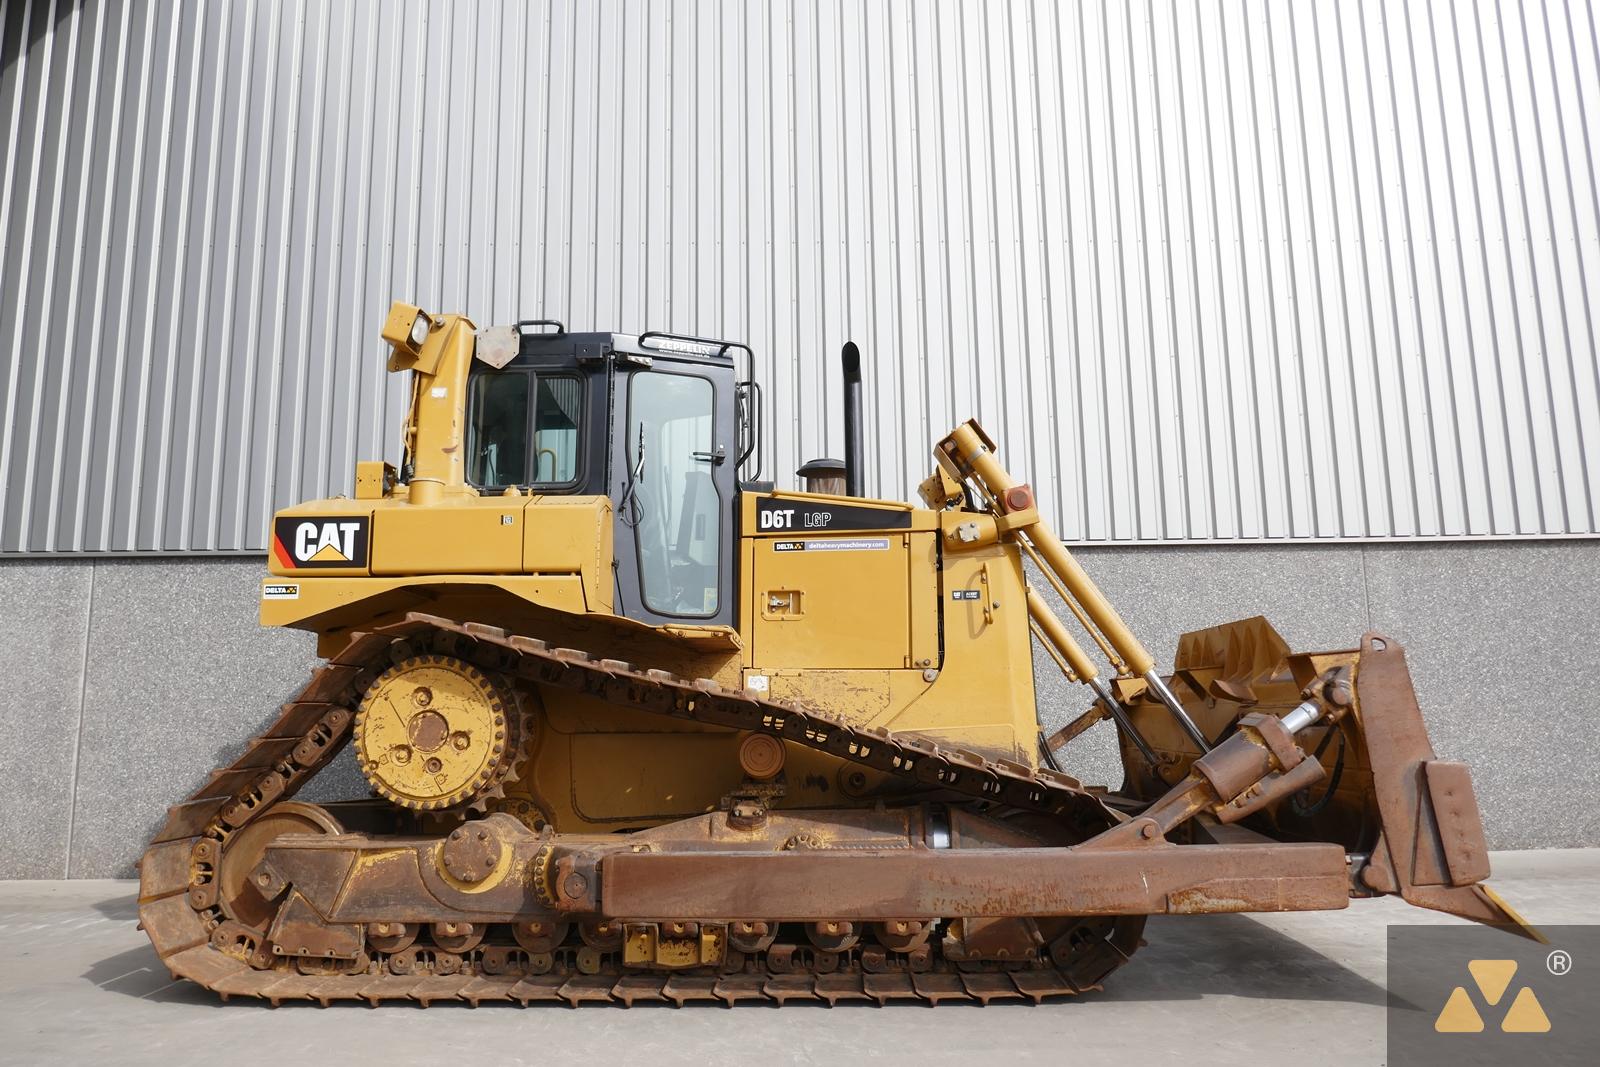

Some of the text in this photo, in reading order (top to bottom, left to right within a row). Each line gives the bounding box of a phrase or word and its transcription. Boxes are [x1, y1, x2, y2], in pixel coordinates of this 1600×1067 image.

[761, 509, 832, 529] D6T LGP
[295, 521, 361, 562] CAT
[776, 543, 794, 551] DELTA
